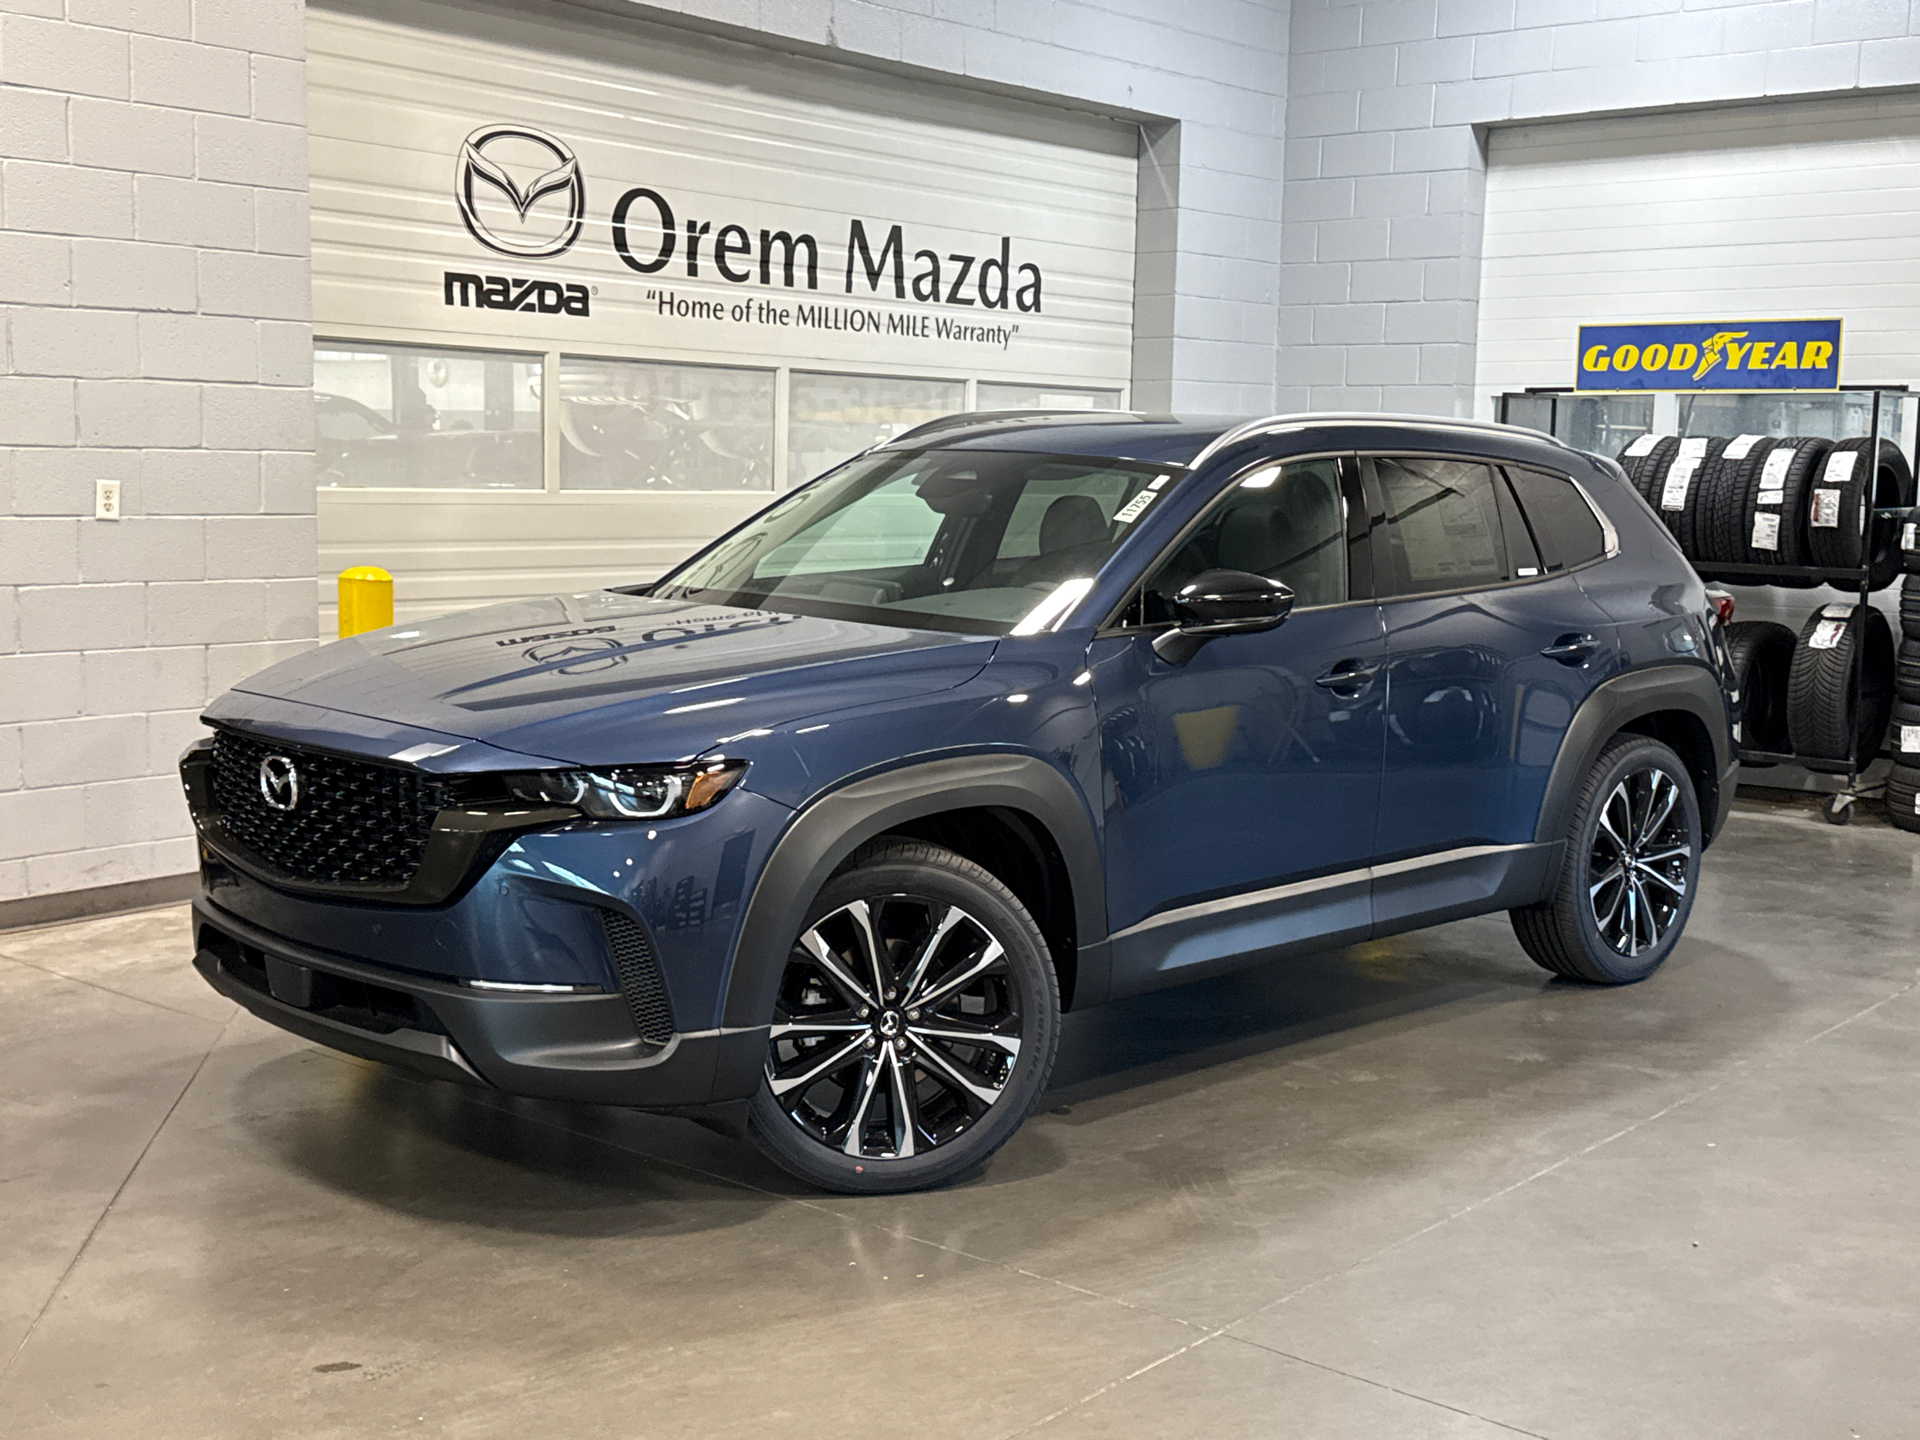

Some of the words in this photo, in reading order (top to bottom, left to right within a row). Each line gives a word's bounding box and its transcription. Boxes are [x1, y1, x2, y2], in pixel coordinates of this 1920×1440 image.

[611, 187, 818, 290] Orem
[844, 219, 1042, 314] Mazda
[731, 303, 753, 323] of
[757, 302, 790, 326] the
[796, 304, 882, 334] MILLION
[886, 313, 930, 339] MILE
[1120, 494, 1152, 518] 11755
